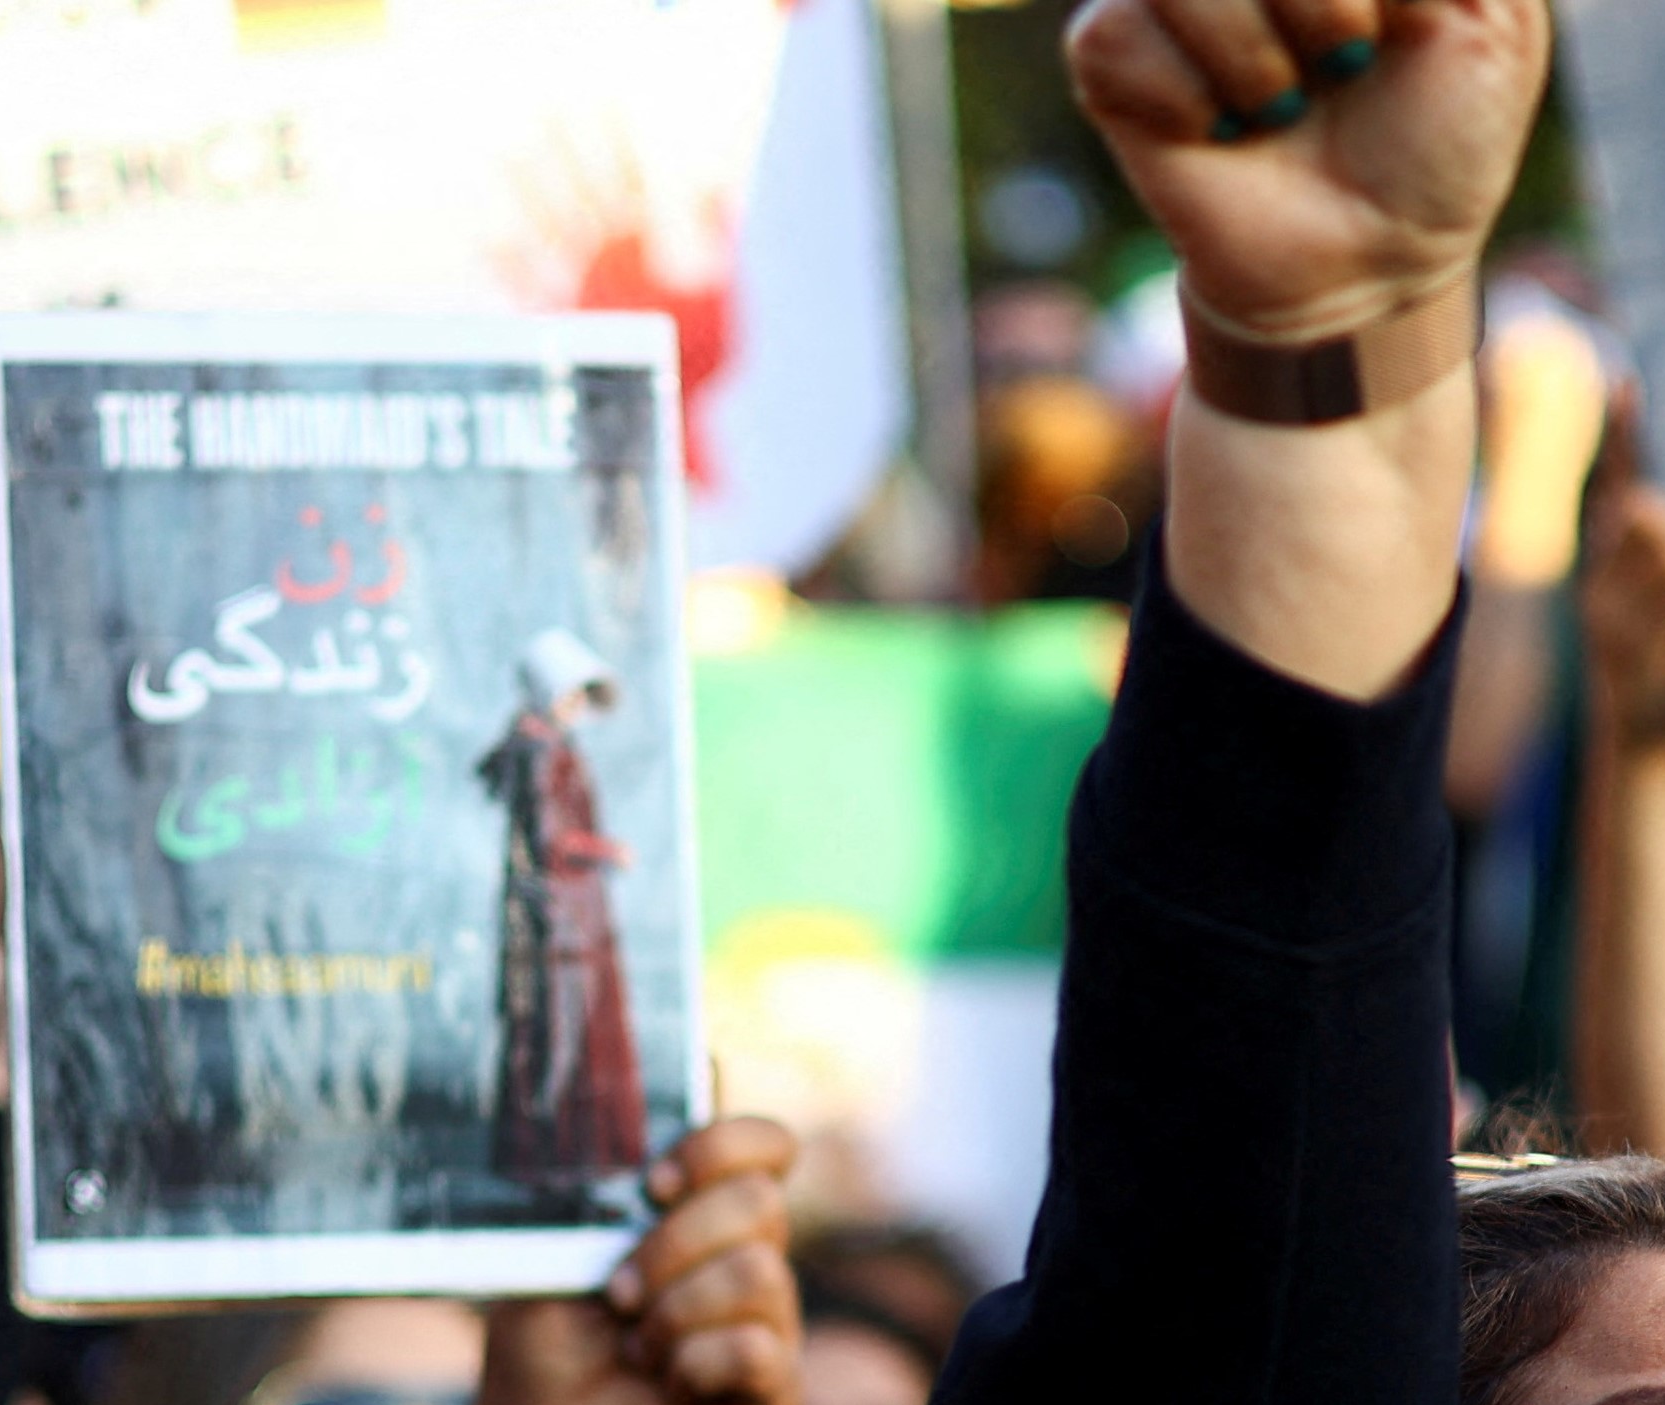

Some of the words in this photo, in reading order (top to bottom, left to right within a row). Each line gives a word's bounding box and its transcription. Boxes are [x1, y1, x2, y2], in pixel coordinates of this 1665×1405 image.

[96, 390, 185, 469] THE
[472, 388, 578, 471] TALE
[276, 503, 408, 604] زن
